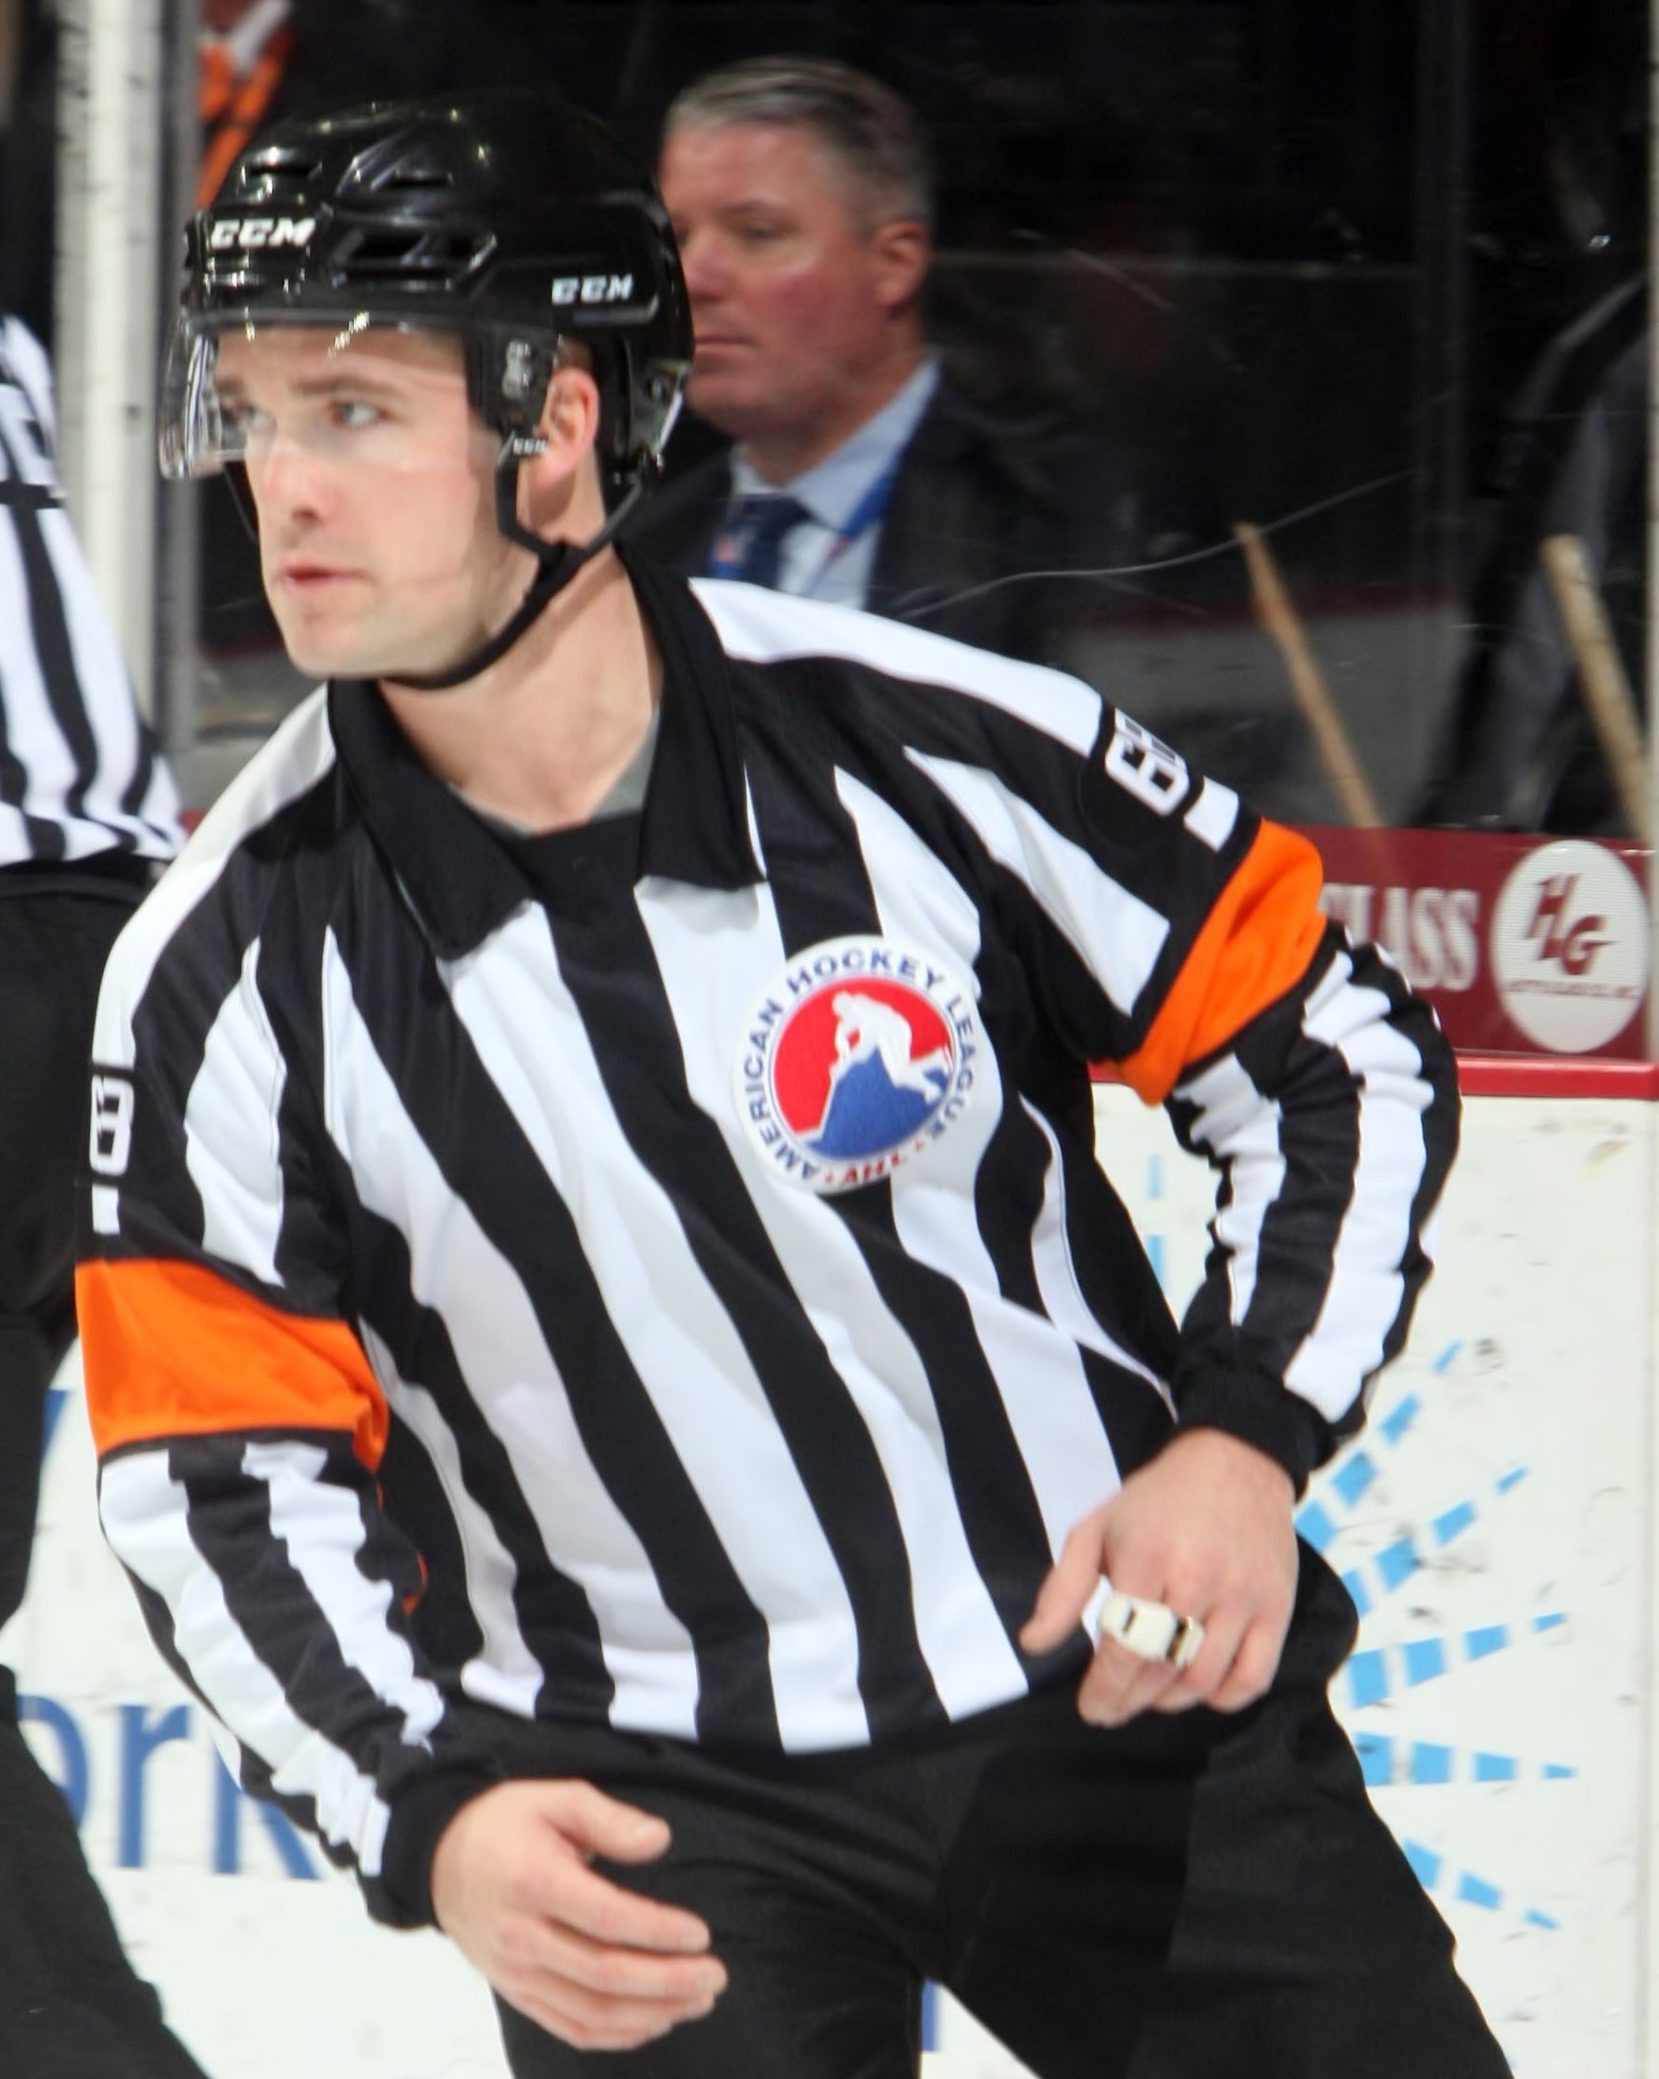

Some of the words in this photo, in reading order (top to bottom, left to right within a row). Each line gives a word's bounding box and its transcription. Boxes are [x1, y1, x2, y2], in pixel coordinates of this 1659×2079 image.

[211, 217, 316, 248] CCM
[551, 274, 633, 304] CCM
[744, 998, 822, 1181] AMERICAN
[786, 949, 945, 995] HOCKEY
[929, 994, 977, 1141] LEAGUE
